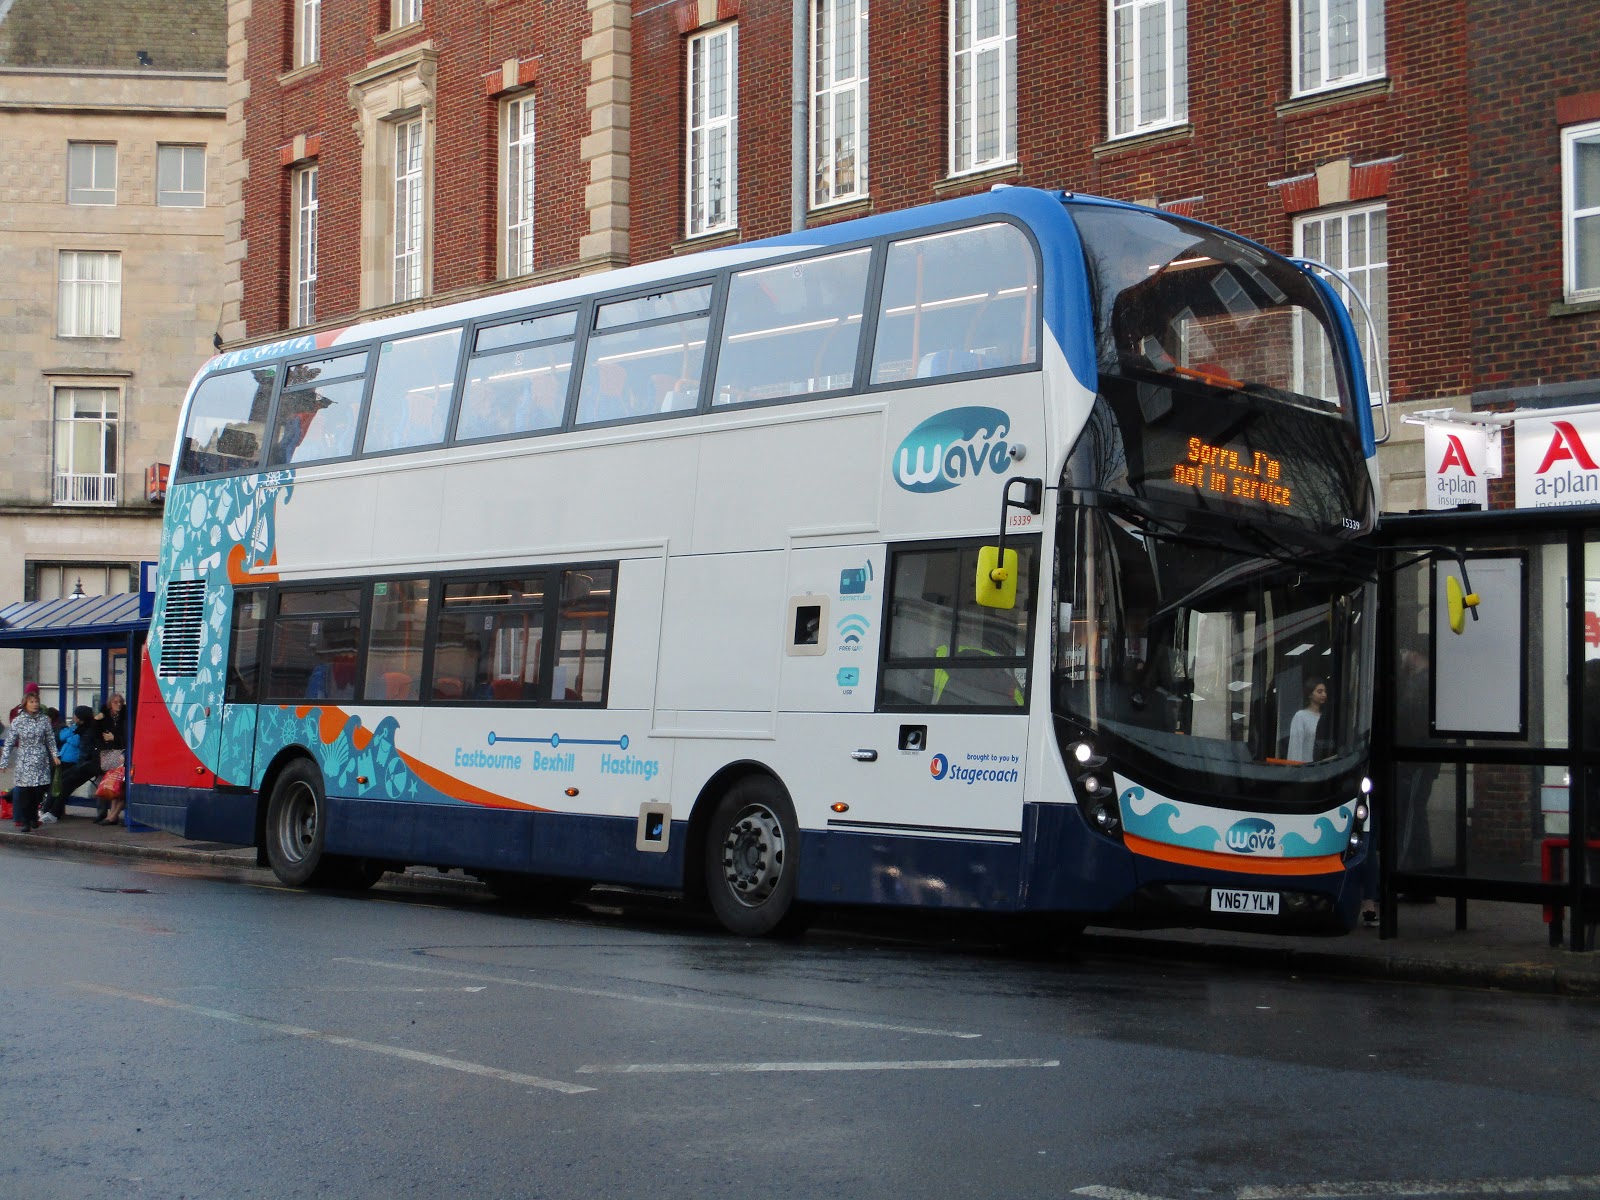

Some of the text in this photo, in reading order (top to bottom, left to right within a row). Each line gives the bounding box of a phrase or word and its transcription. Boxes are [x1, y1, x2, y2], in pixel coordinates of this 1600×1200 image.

[1174, 464, 1292, 507] not in service
[1437, 475, 1477, 494] a-plan
[1535, 470, 1599, 498] a-plan
[1009, 515, 1032, 526] 15339
[1342, 517, 1360, 531] 15339
[454, 747, 522, 770] Eastbourne
[533, 750, 575, 772] Bexhill
[601, 752, 659, 781] Hastings
[966, 752, 1020, 764] brought to you by
[949, 764, 1019, 785] Stagecoach
[1217, 891, 1275, 911] YN67 YLM
